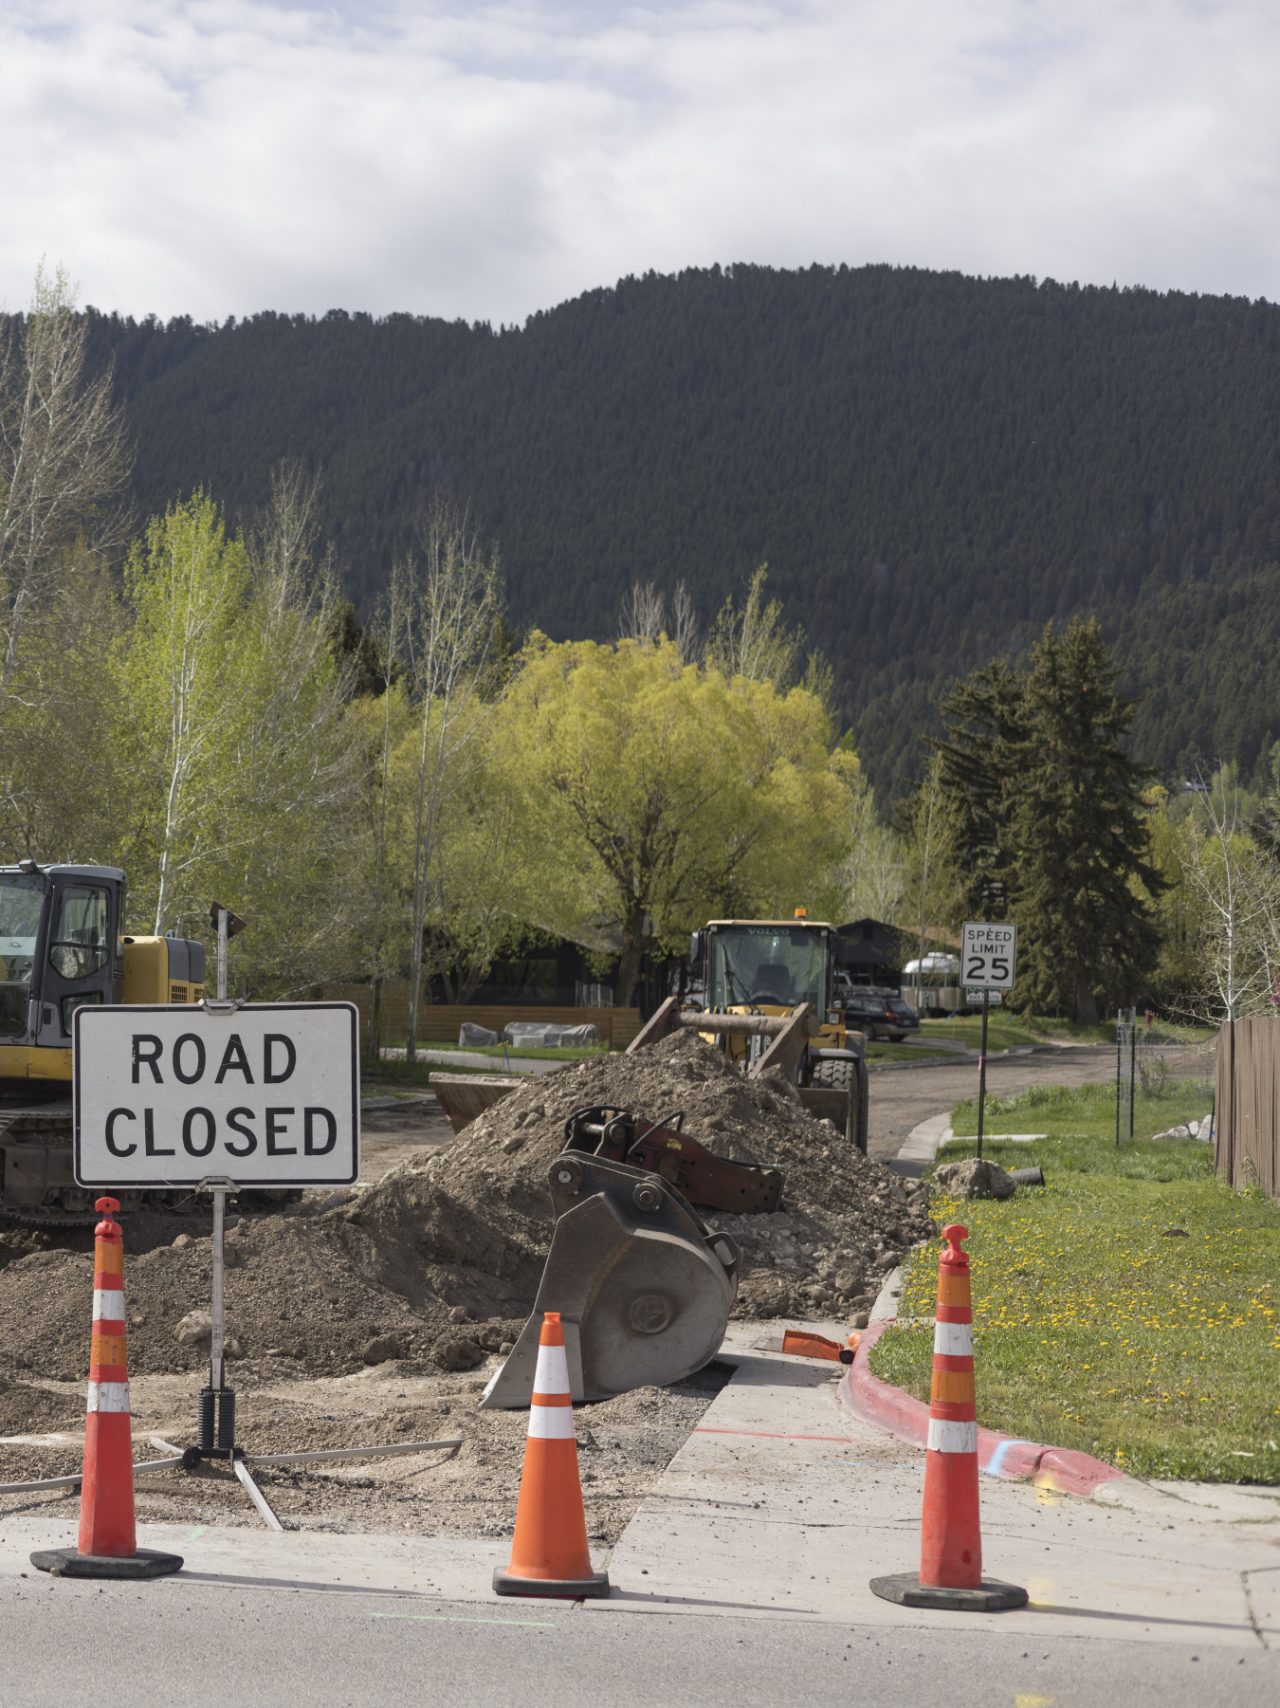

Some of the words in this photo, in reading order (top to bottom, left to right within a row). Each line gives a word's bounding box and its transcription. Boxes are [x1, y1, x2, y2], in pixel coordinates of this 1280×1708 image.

[747, 927, 790, 935] VOLVO
[968, 929, 1012, 942] SPEED
[971, 944, 1006, 954] LIMIT
[966, 956, 1010, 981] 25
[131, 1033, 297, 1085] ROAD
[104, 1106, 338, 1158] CLOSED
